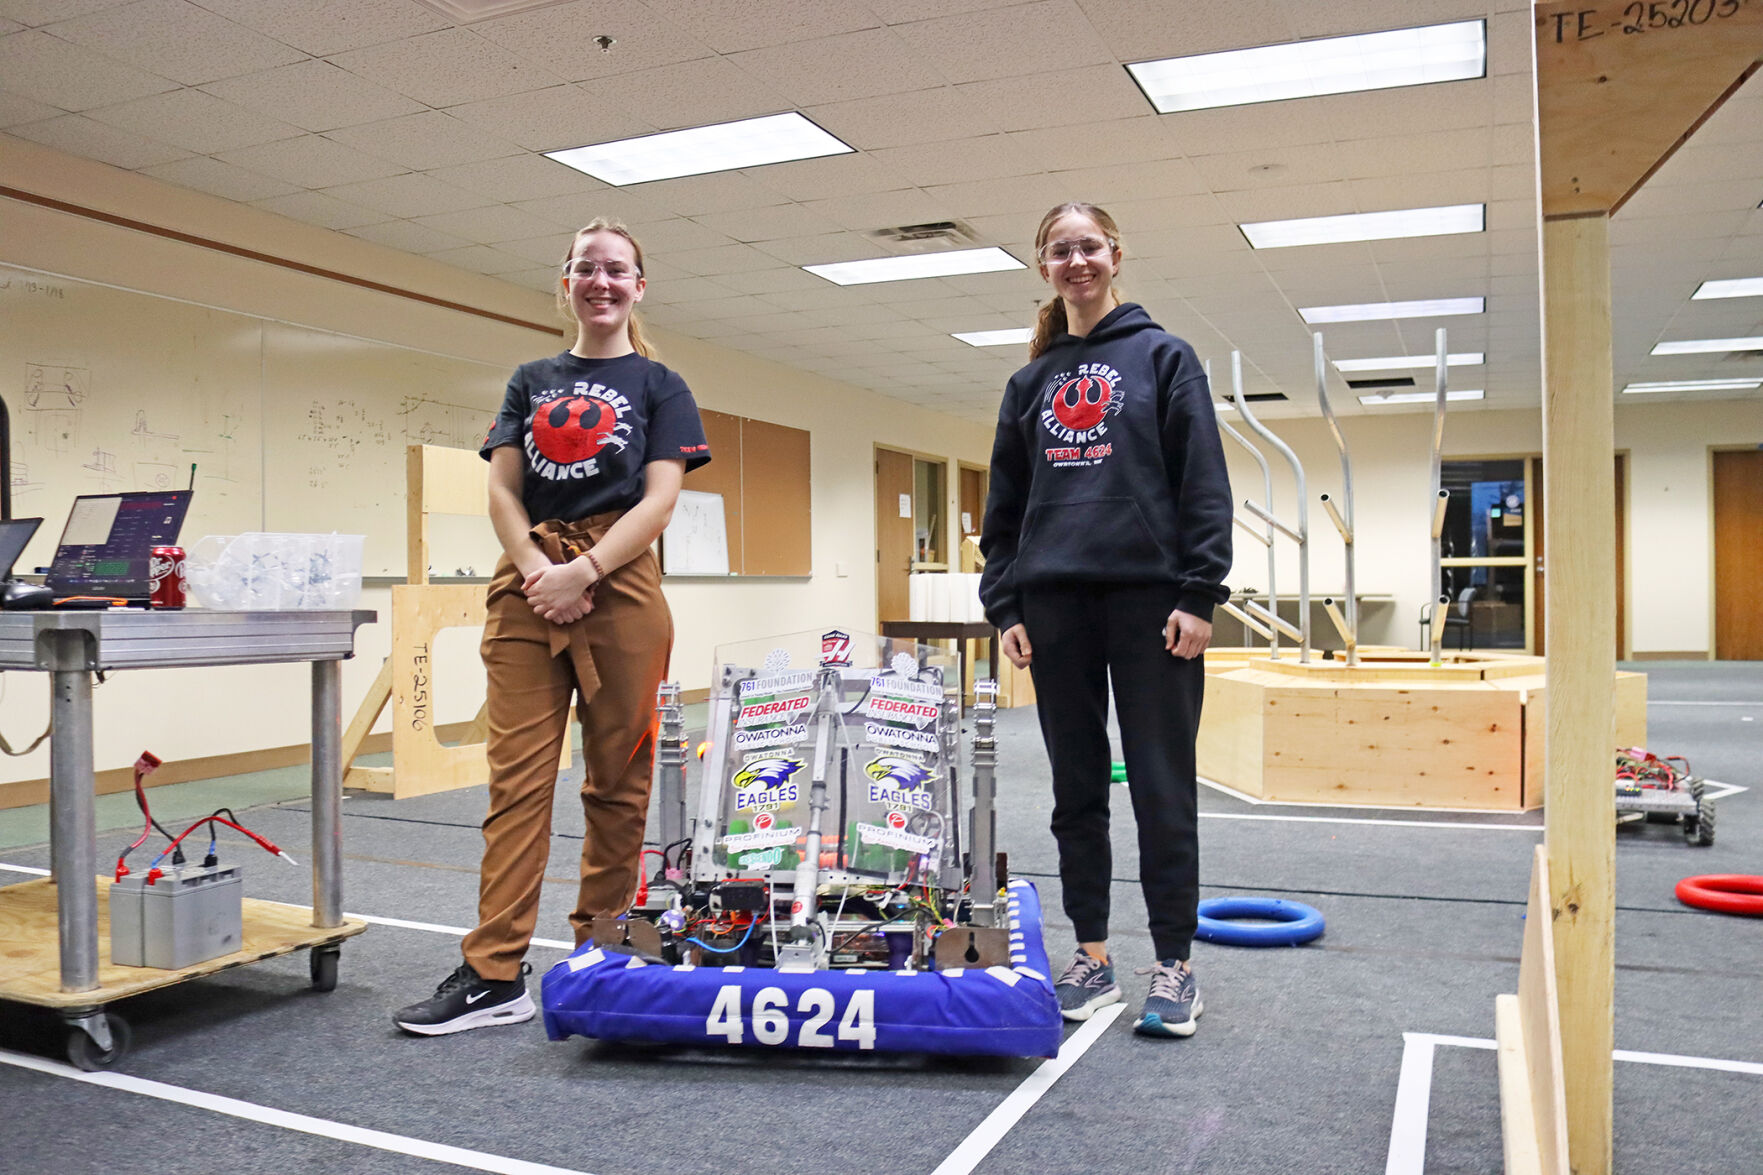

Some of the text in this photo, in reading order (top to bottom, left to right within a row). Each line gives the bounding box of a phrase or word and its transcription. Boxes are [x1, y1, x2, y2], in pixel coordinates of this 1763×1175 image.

[1078, 363, 1122, 388] REBEL
[573, 381, 633, 419] REBEL
[1041, 409, 1108, 444] ALLIANCE
[524, 431, 600, 481] ALLIANCE
[1045, 443, 1113, 461] TEAM 4624
[741, 681, 755, 692] 761
[756, 672, 813, 689] FOUNDATION
[887, 679, 941, 696] FOUNDATION
[741, 697, 809, 719] FEDERATED
[870, 698, 938, 718] FEDERATED
[736, 725, 807, 743] OWATONNA
[867, 725, 937, 744] OWATONNA
[744, 749, 793, 761] OWATONNA
[737, 785, 797, 809] EAGLES
[870, 786, 930, 810] EAGLES
[725, 828, 800, 842] PROFINIUM
[706, 984, 877, 1050] 4624
